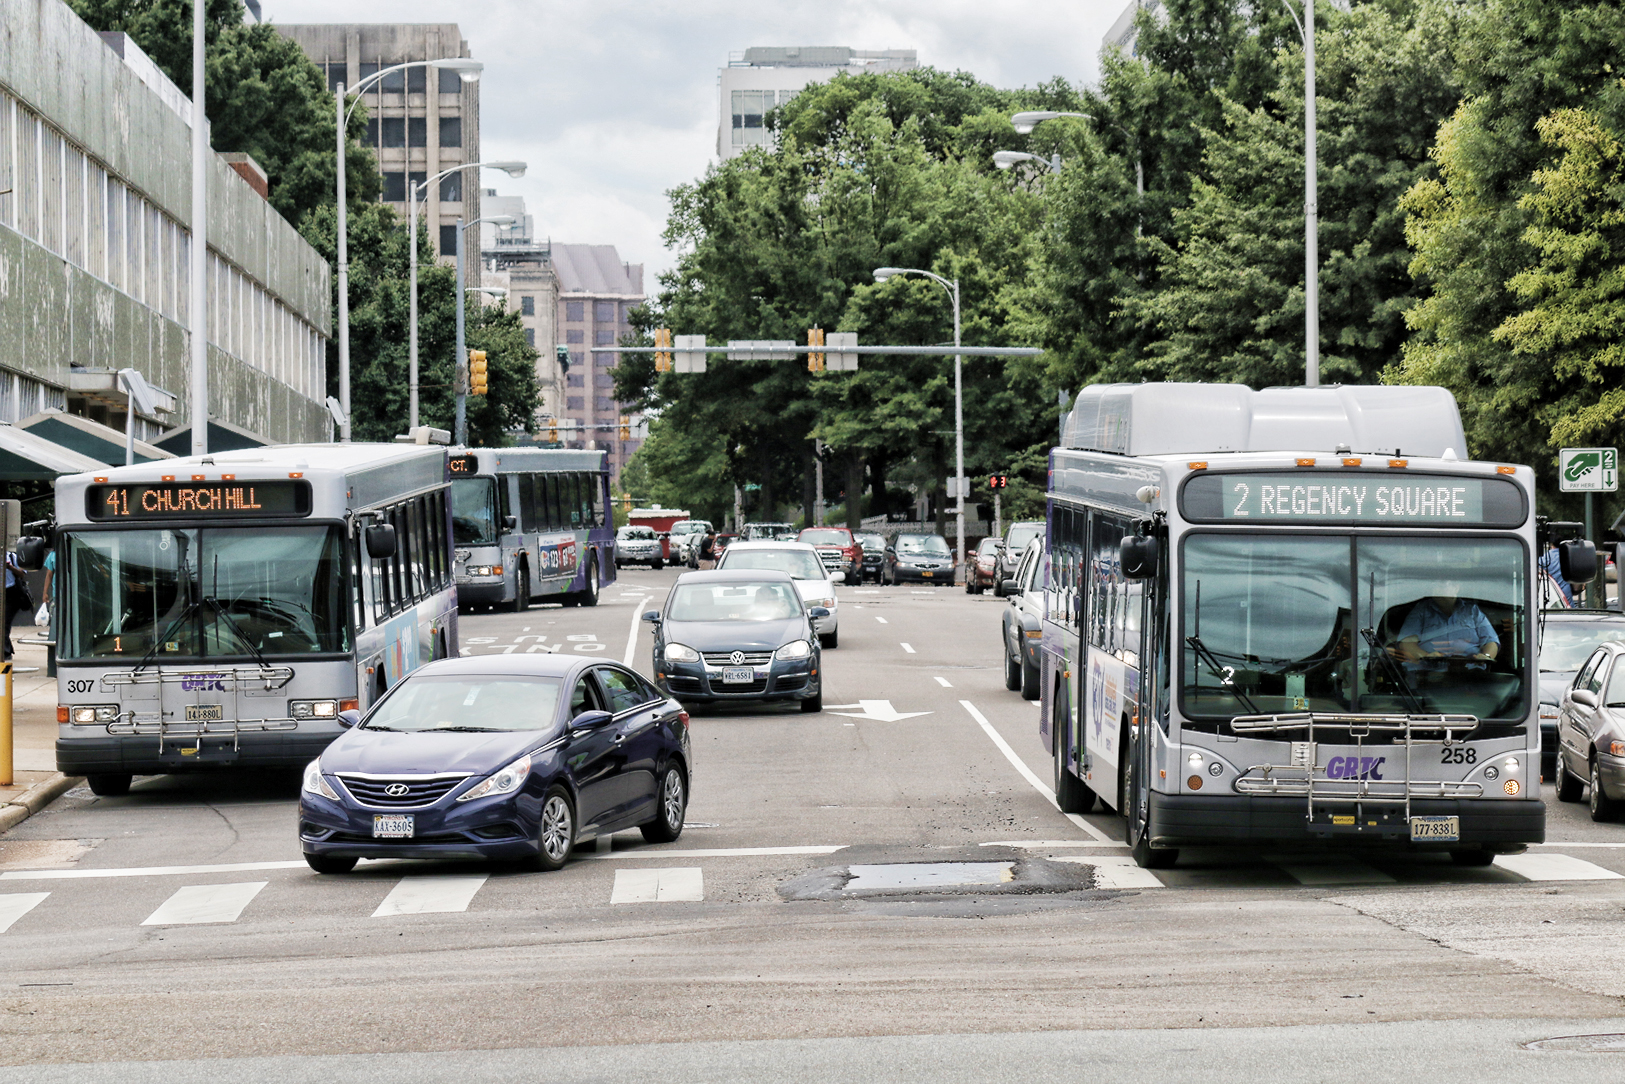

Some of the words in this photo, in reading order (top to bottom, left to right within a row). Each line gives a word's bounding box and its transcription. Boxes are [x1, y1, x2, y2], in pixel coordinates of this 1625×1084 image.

[1604, 450, 1613, 462] 2
[106, 489, 130, 515] 41
[142, 488, 221, 511] CHURCH
[225, 487, 262, 510] HILL
[1233, 483, 1250, 516] 2
[1260, 485, 1367, 515] REGENCY
[1375, 486, 1466, 516] SQUARE
[113, 636, 123, 652] 1
[465, 634, 598, 645] BUS
[1220, 665, 1235, 685] 2
[67, 680, 95, 693] 307
[1441, 748, 1477, 764] 258
[1326, 756, 1386, 780] GRTC
[374, 821, 413, 832] KAX-3605
[1414, 823, 1456, 835] 177-838L
